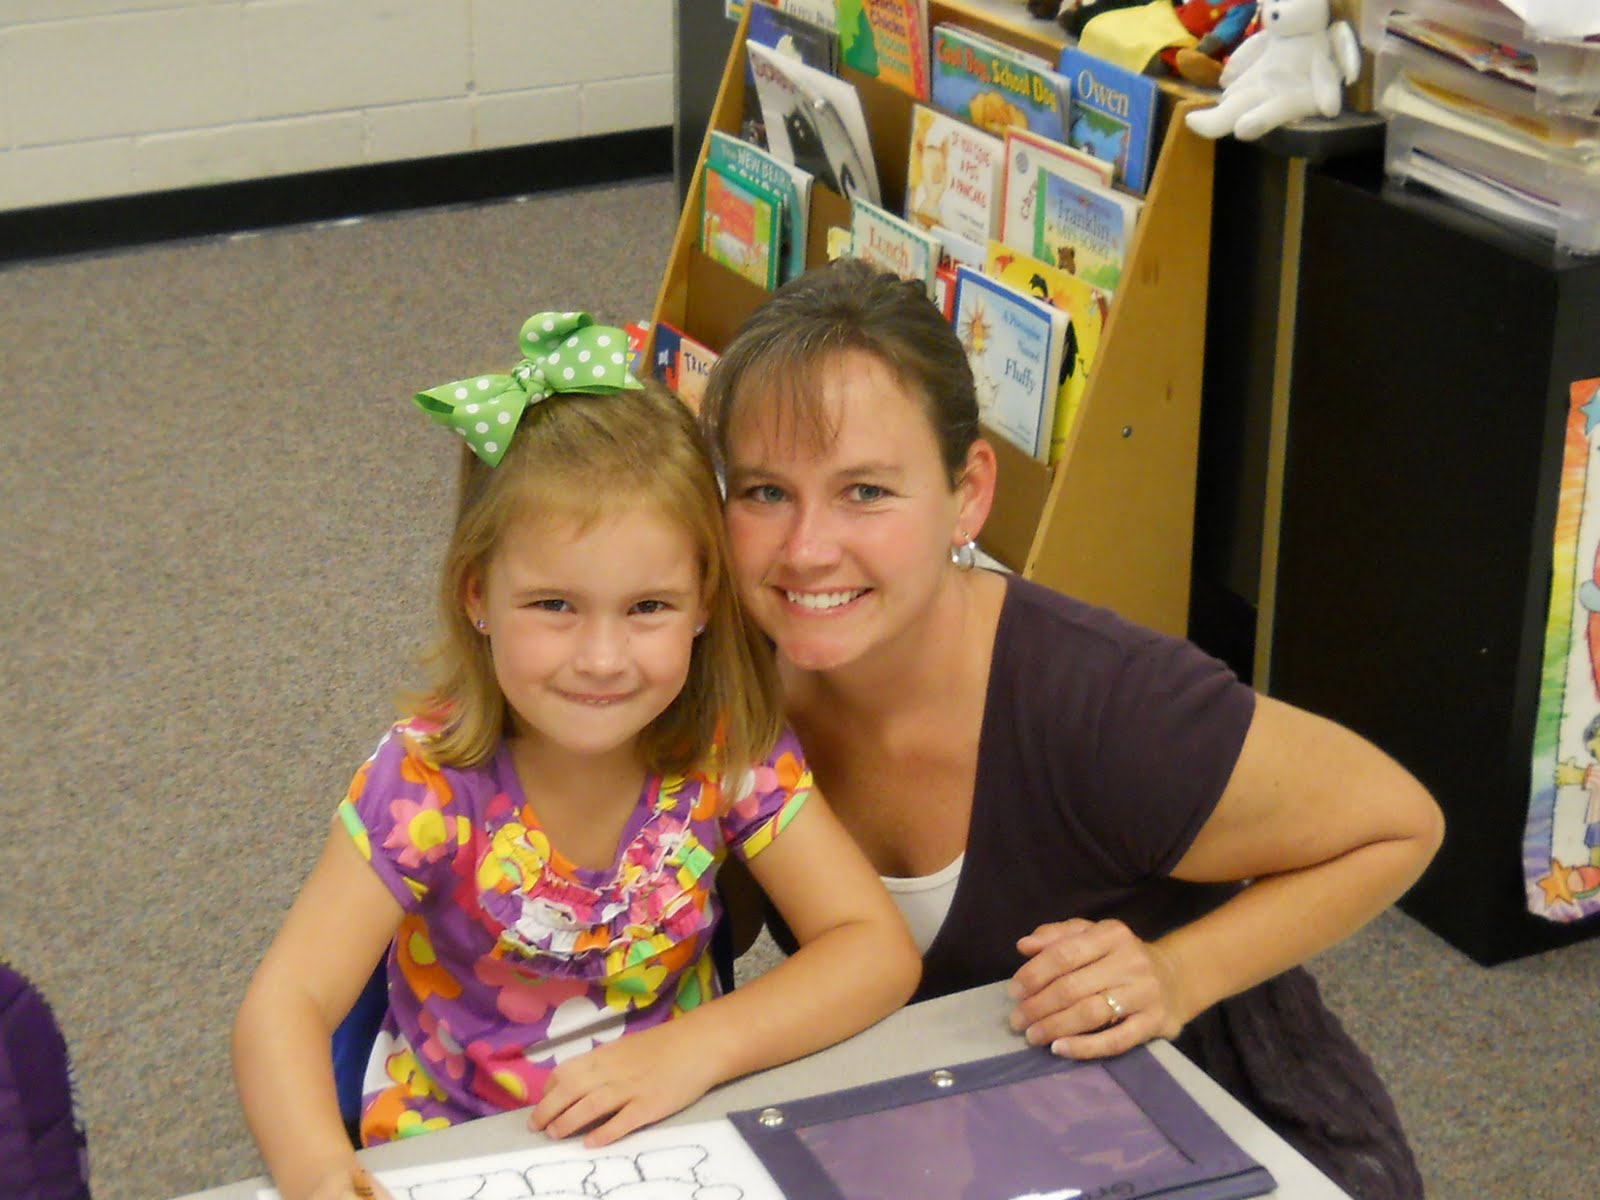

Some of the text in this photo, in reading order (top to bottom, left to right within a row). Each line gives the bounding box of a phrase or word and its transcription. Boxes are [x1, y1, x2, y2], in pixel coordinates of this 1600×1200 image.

[936, 39, 962, 67] Cool
[992, 58, 1031, 96] School
[1077, 69, 1129, 118] Owen
[1058, 199, 1109, 241] Franklin
[869, 226, 909, 269] Lunch
[1004, 358, 1037, 396] Fluffy
